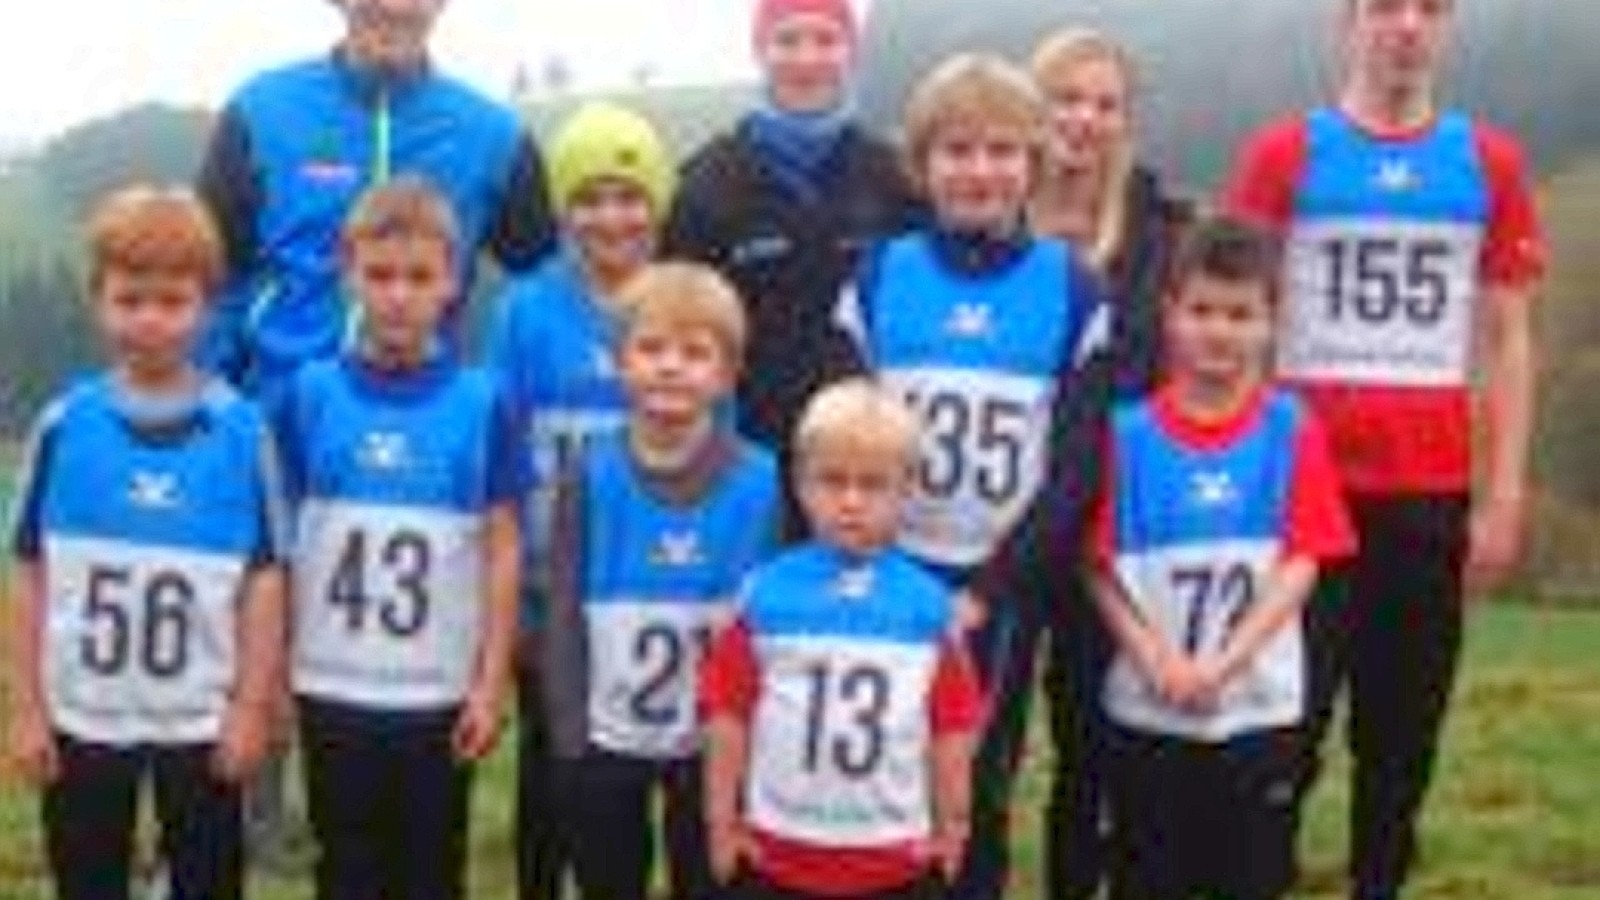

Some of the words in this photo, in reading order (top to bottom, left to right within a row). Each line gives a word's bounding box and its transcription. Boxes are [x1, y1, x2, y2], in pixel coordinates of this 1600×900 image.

[1317, 239, 1452, 323] 155
[905, 391, 1027, 502] 35
[80, 566, 195, 678] 56
[327, 530, 432, 637] 43
[630, 624, 712, 727] 2
[799, 662, 891, 776] 13
